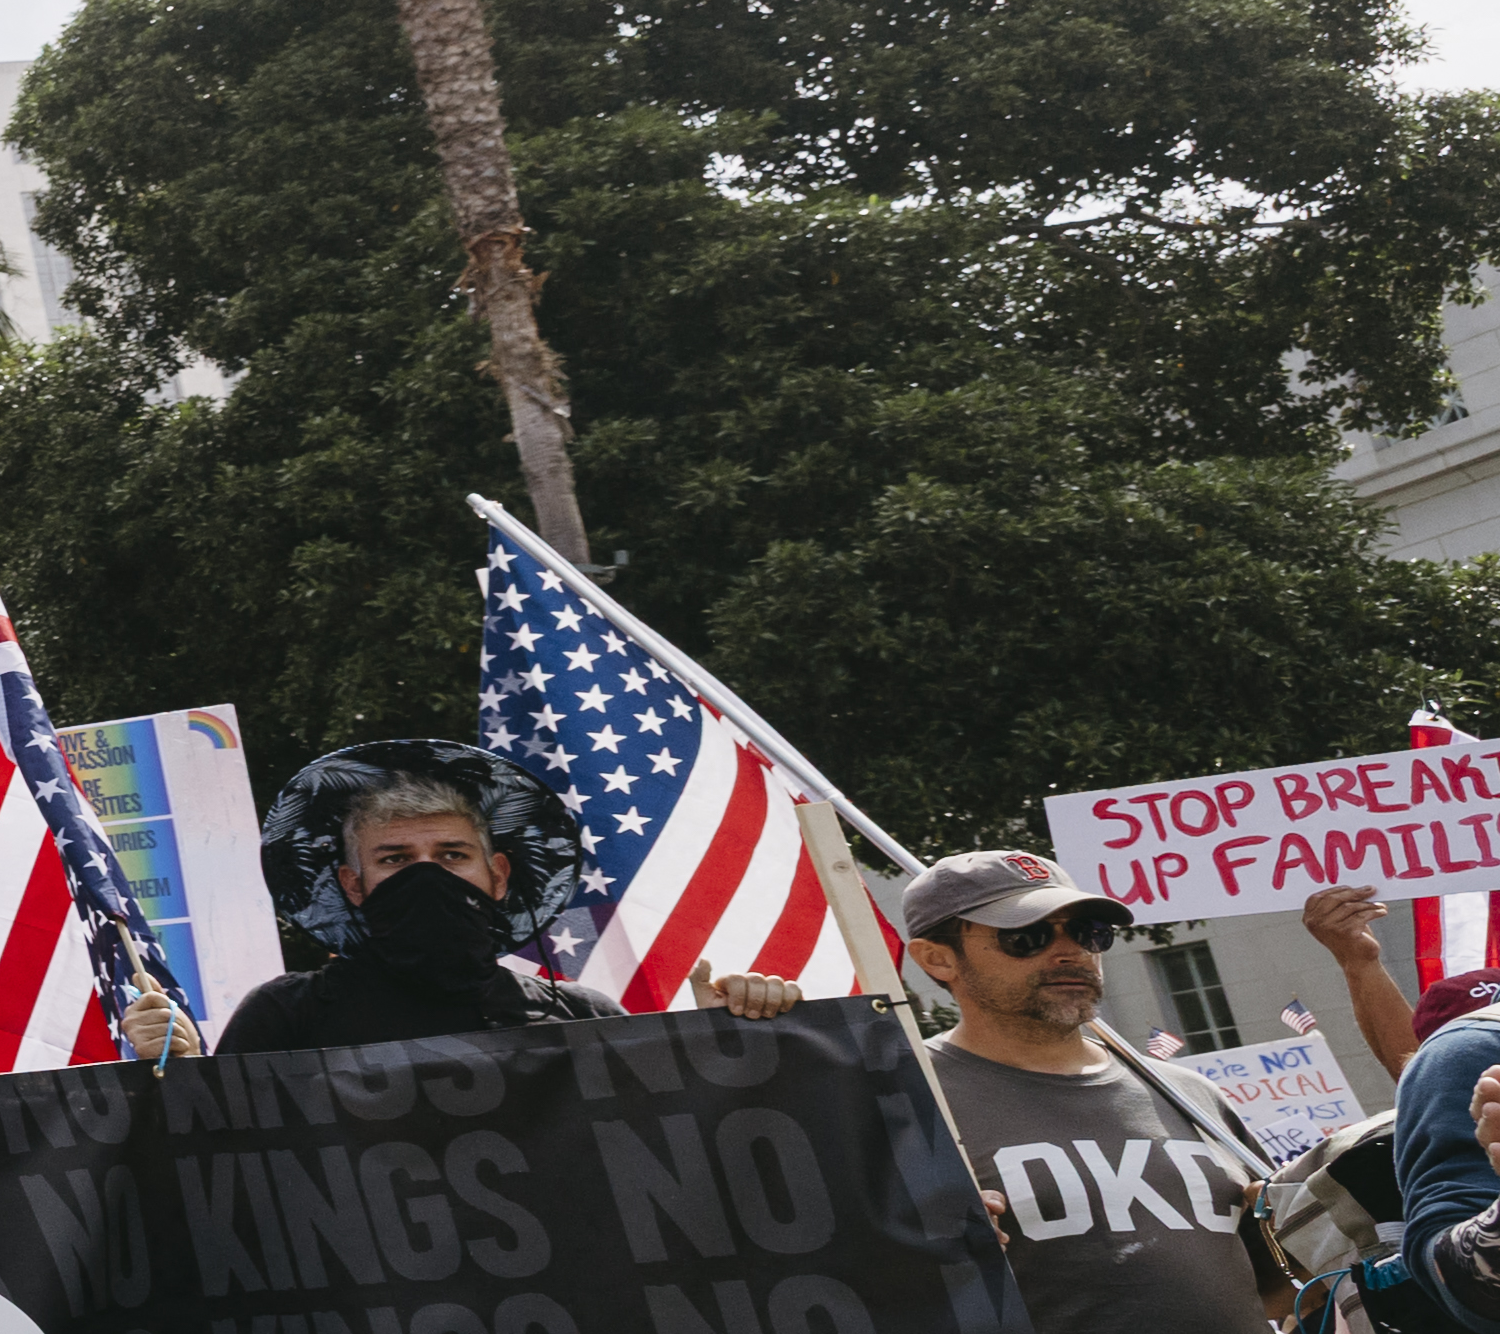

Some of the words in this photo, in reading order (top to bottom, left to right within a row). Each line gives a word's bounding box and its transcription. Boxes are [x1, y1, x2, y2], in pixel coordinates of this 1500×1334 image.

[94, 729, 110, 749] &
[69, 745, 136, 771] PASSION
[1092, 780, 1255, 849] STOP
[1099, 852, 1189, 905] UP
[1212, 813, 1500, 897] FAMILI
[1258, 1044, 1313, 1074] NOT
[1220, 1070, 1343, 1104] ADICAL
[1256, 1127, 1310, 1155] the
[175, 1130, 550, 1297] KINGS
[591, 1107, 836, 1265] NO
